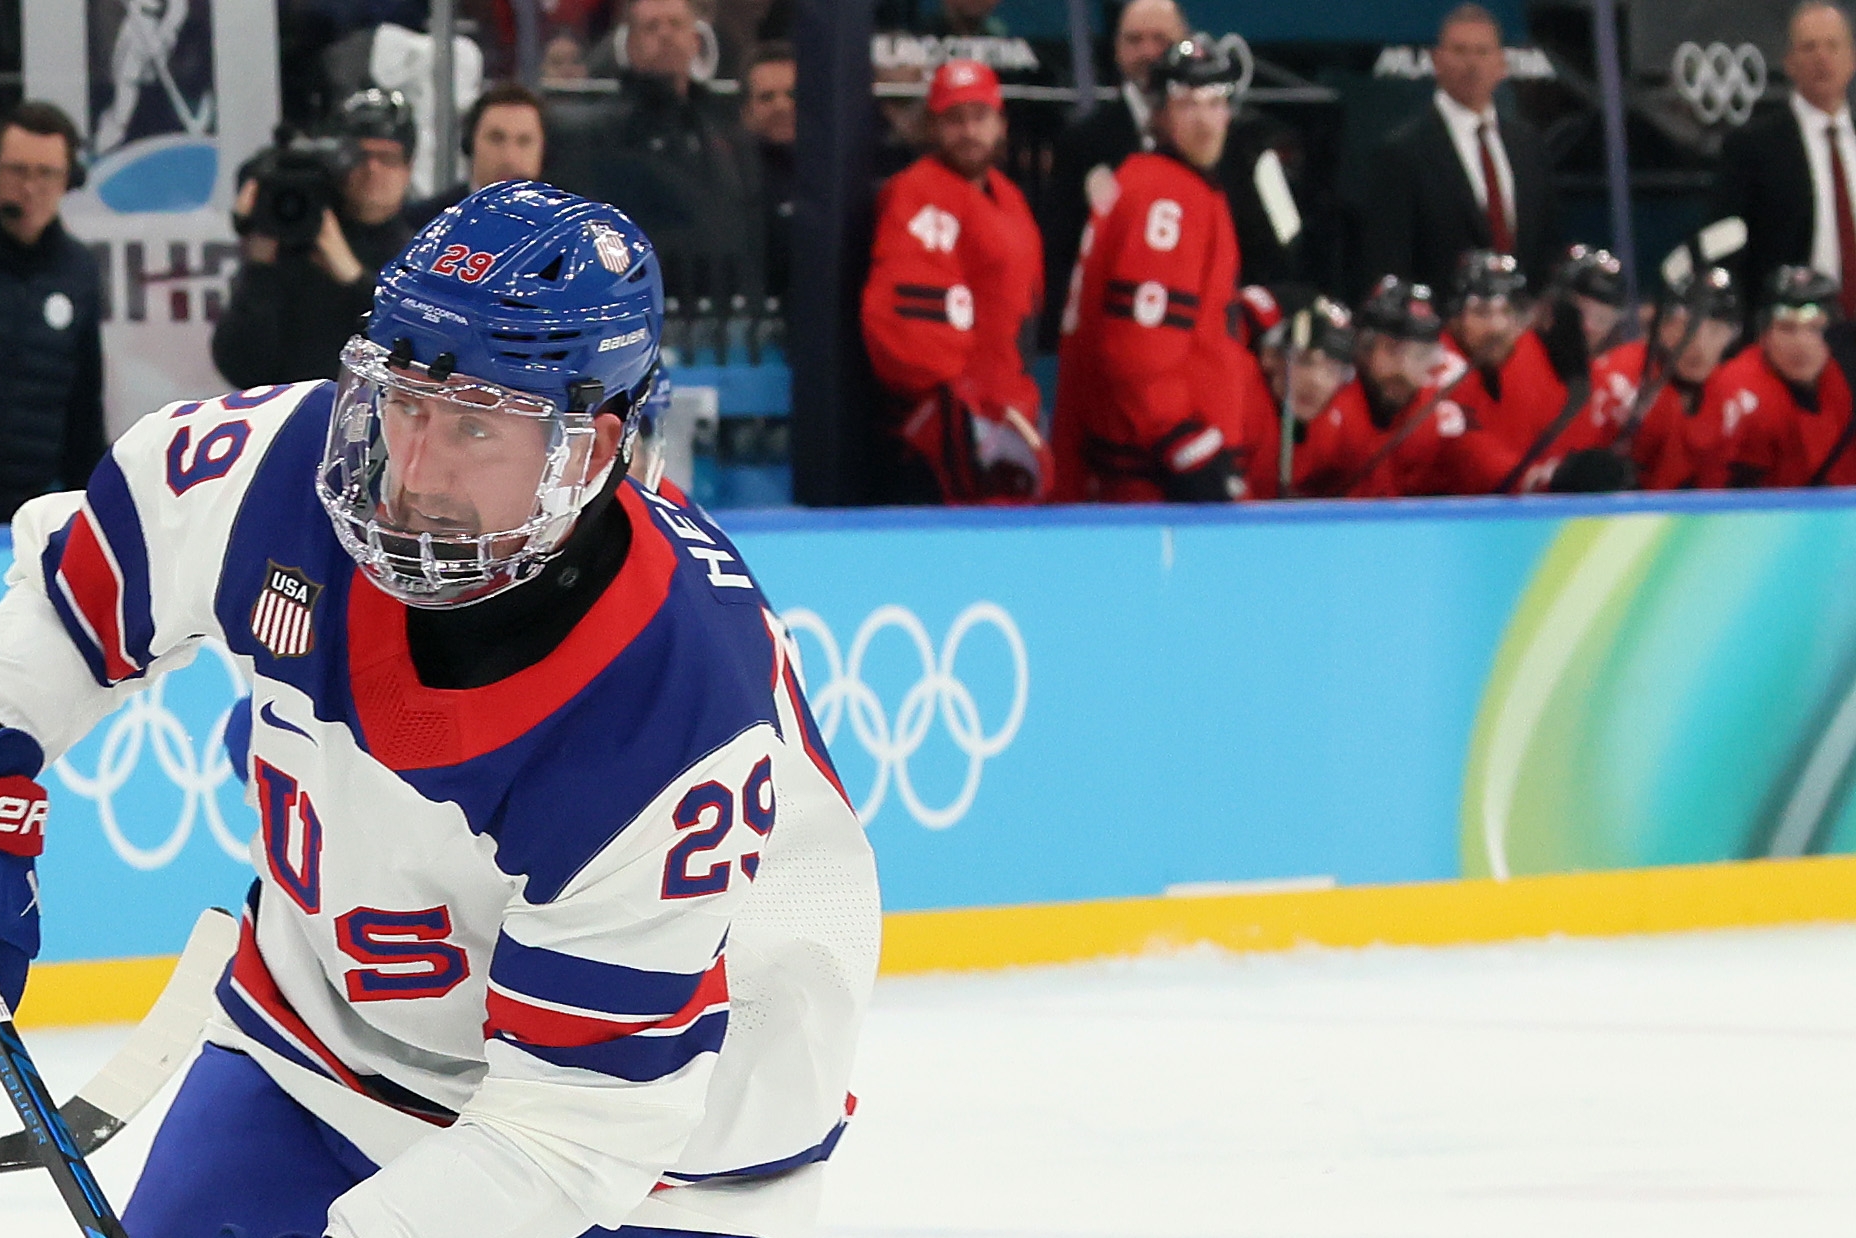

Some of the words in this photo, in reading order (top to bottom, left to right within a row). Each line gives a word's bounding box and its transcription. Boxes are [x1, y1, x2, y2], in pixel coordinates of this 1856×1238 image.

[1145, 198, 1184, 251] 6
[430, 243, 496, 284] 29
[597, 327, 647, 353] BAUER
[270, 571, 311, 604] USA
